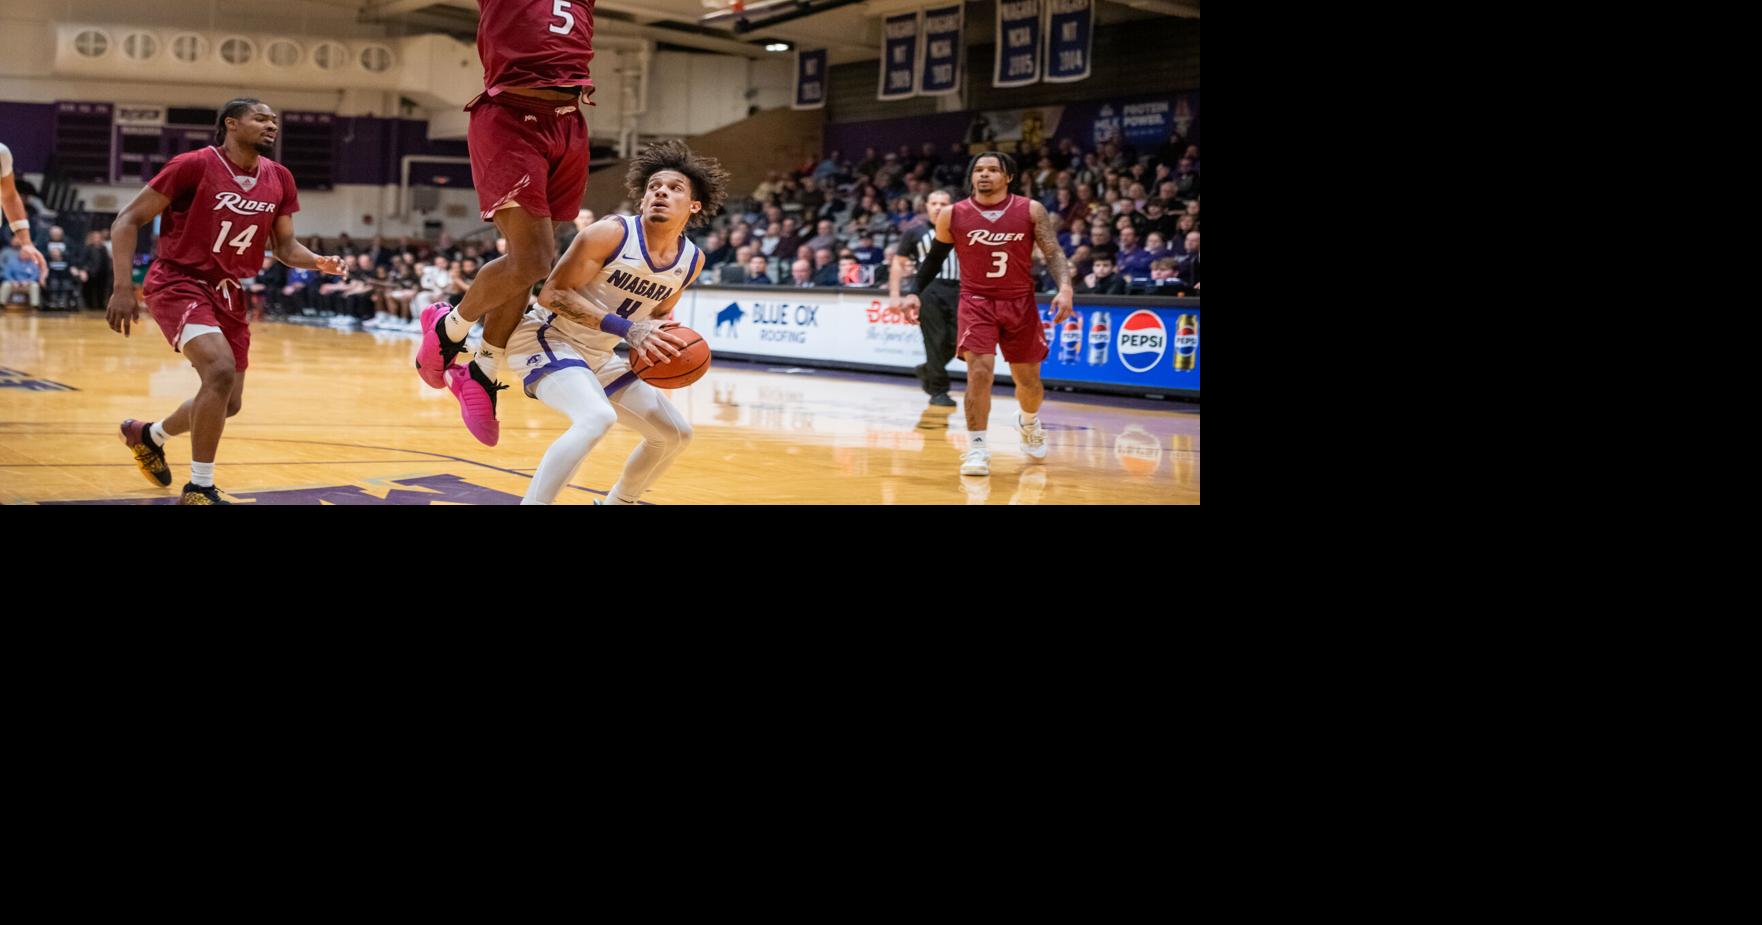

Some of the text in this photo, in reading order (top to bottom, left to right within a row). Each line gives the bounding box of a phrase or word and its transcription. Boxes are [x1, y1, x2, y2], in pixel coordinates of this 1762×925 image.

[549, 0, 575, 35] 5
[212, 220, 258, 255] 14
[986, 251, 1008, 278] 3
[606, 269, 673, 301] NIAGARA
[752, 303, 819, 326] BLUE OX
[760, 329, 806, 344] ROOFING
[1121, 334, 1163, 348] PEPSI
